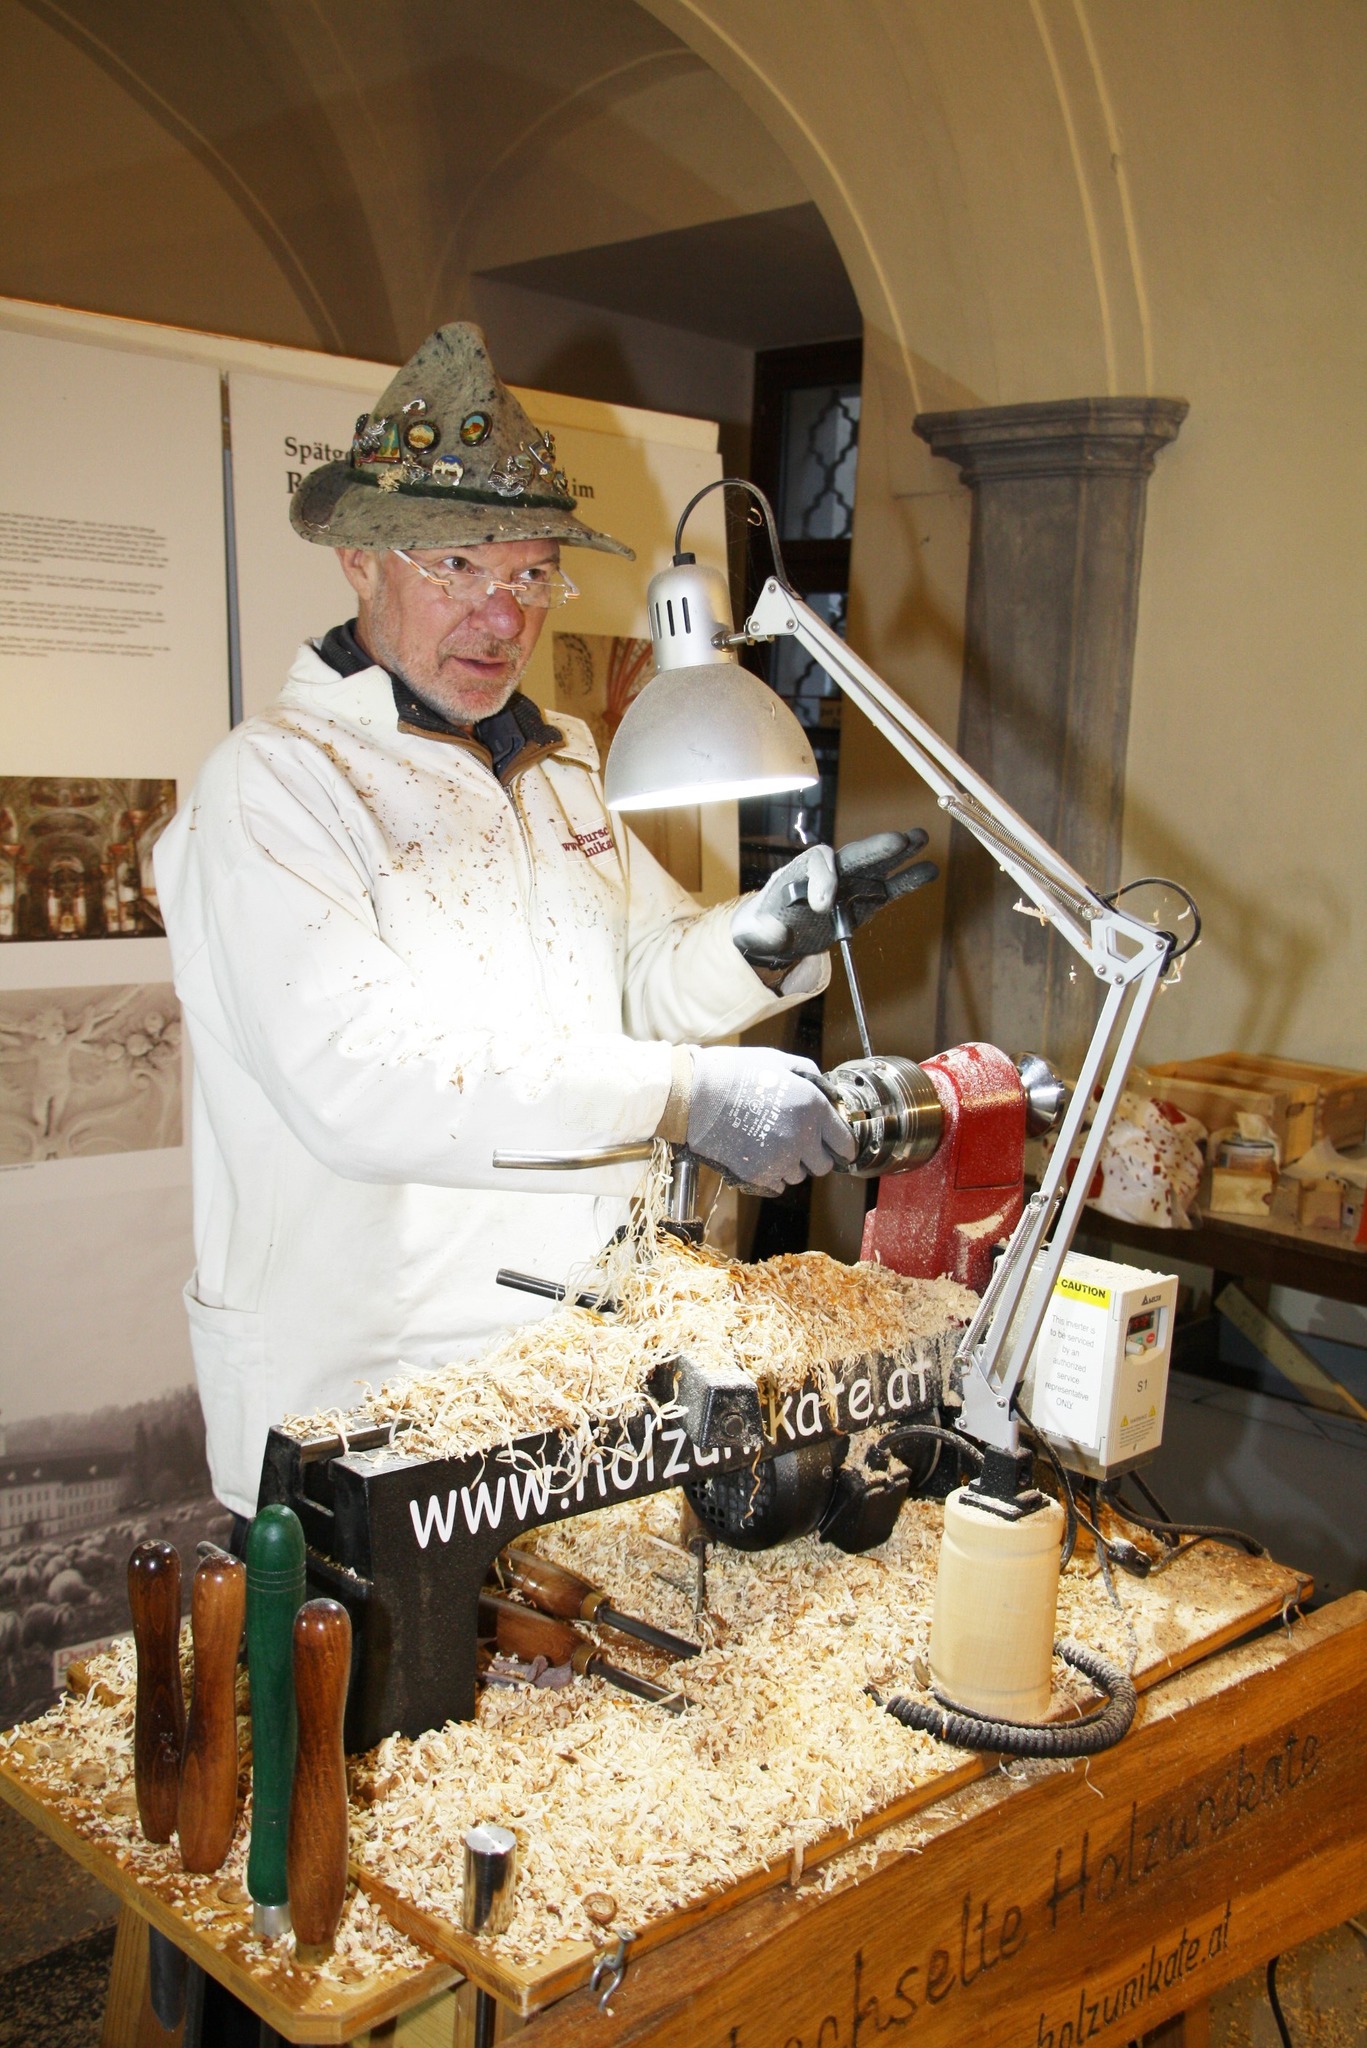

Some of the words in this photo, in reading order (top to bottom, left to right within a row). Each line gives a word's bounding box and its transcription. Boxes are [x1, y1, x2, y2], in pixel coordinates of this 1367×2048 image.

[575, 825, 610, 846] Bursc
[1060, 1279, 1106, 1299] CAUTION
[1050, 1328, 1057, 1337] to
[1058, 1330, 1066, 1340] be
[1067, 1334, 1095, 1348] serviced
[1052, 1357, 1087, 1373] authorized
[1056, 1371, 1080, 1385] service
[1136, 1378, 1148, 1393] S1
[1045, 1381, 1089, 1401] representative
[1055, 1397, 1074, 1410] ONLY
[1046, 1731, 1322, 1933] Holzunikate
